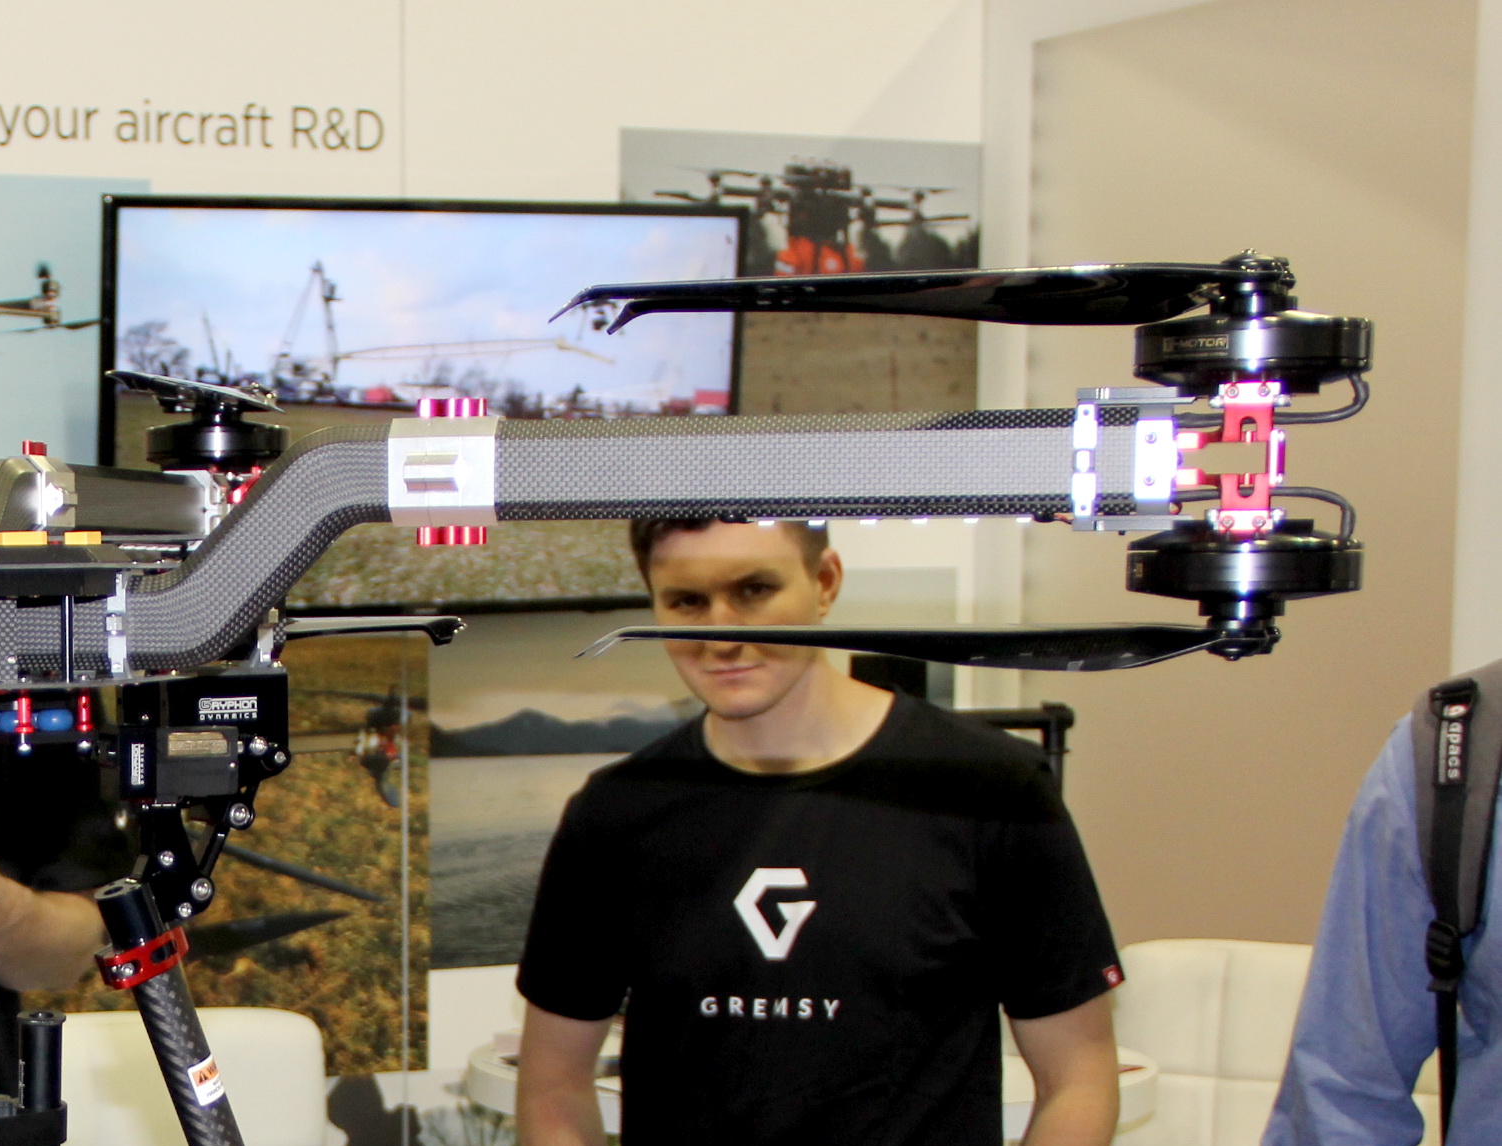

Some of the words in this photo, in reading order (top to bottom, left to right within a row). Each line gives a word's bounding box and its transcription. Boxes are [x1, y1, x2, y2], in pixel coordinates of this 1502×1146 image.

[115, 99, 274, 149] aircraft
[291, 106, 385, 151] R&D
[199, 697, 258, 713] GRYPHON
[199, 713, 258, 721] DYNAMICS
[700, 996, 841, 1021] GREMSY
